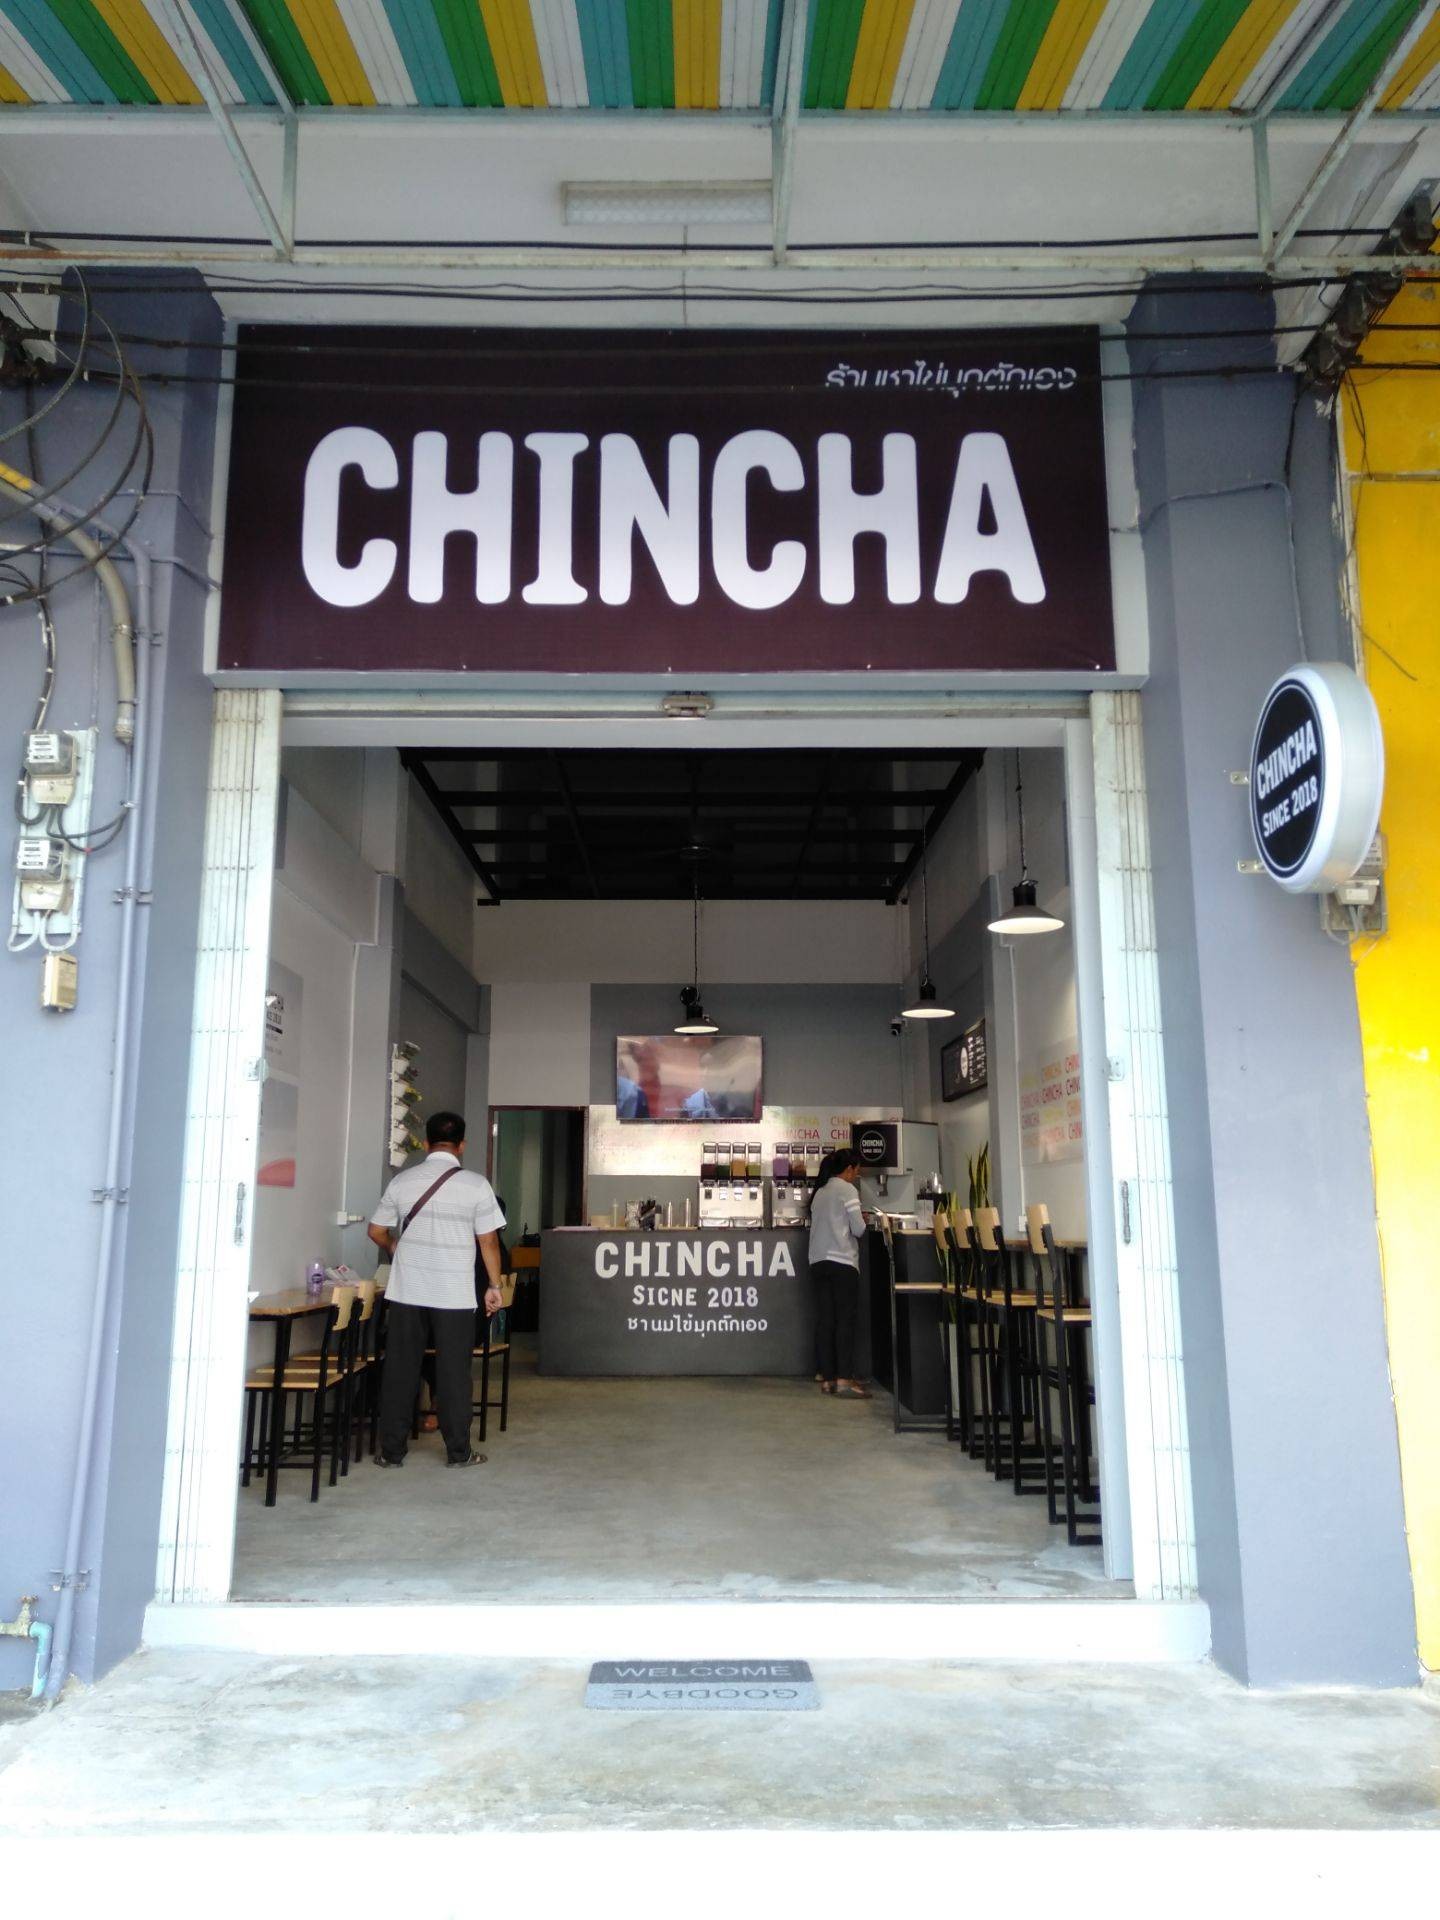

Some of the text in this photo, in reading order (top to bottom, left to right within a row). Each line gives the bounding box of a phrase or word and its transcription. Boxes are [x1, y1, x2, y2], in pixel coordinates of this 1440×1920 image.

[302, 426, 1046, 610] CHINCHA
[1256, 719, 1317, 800] CHINCHA
[1261, 775, 1318, 838] SINCE 2018
[594, 1240, 796, 1278] CHINCHA
[632, 1284, 759, 1308] SICNE 2018
[614, 1665, 792, 1677] WELCOME
[612, 1688, 798, 1699] GOODBYE
